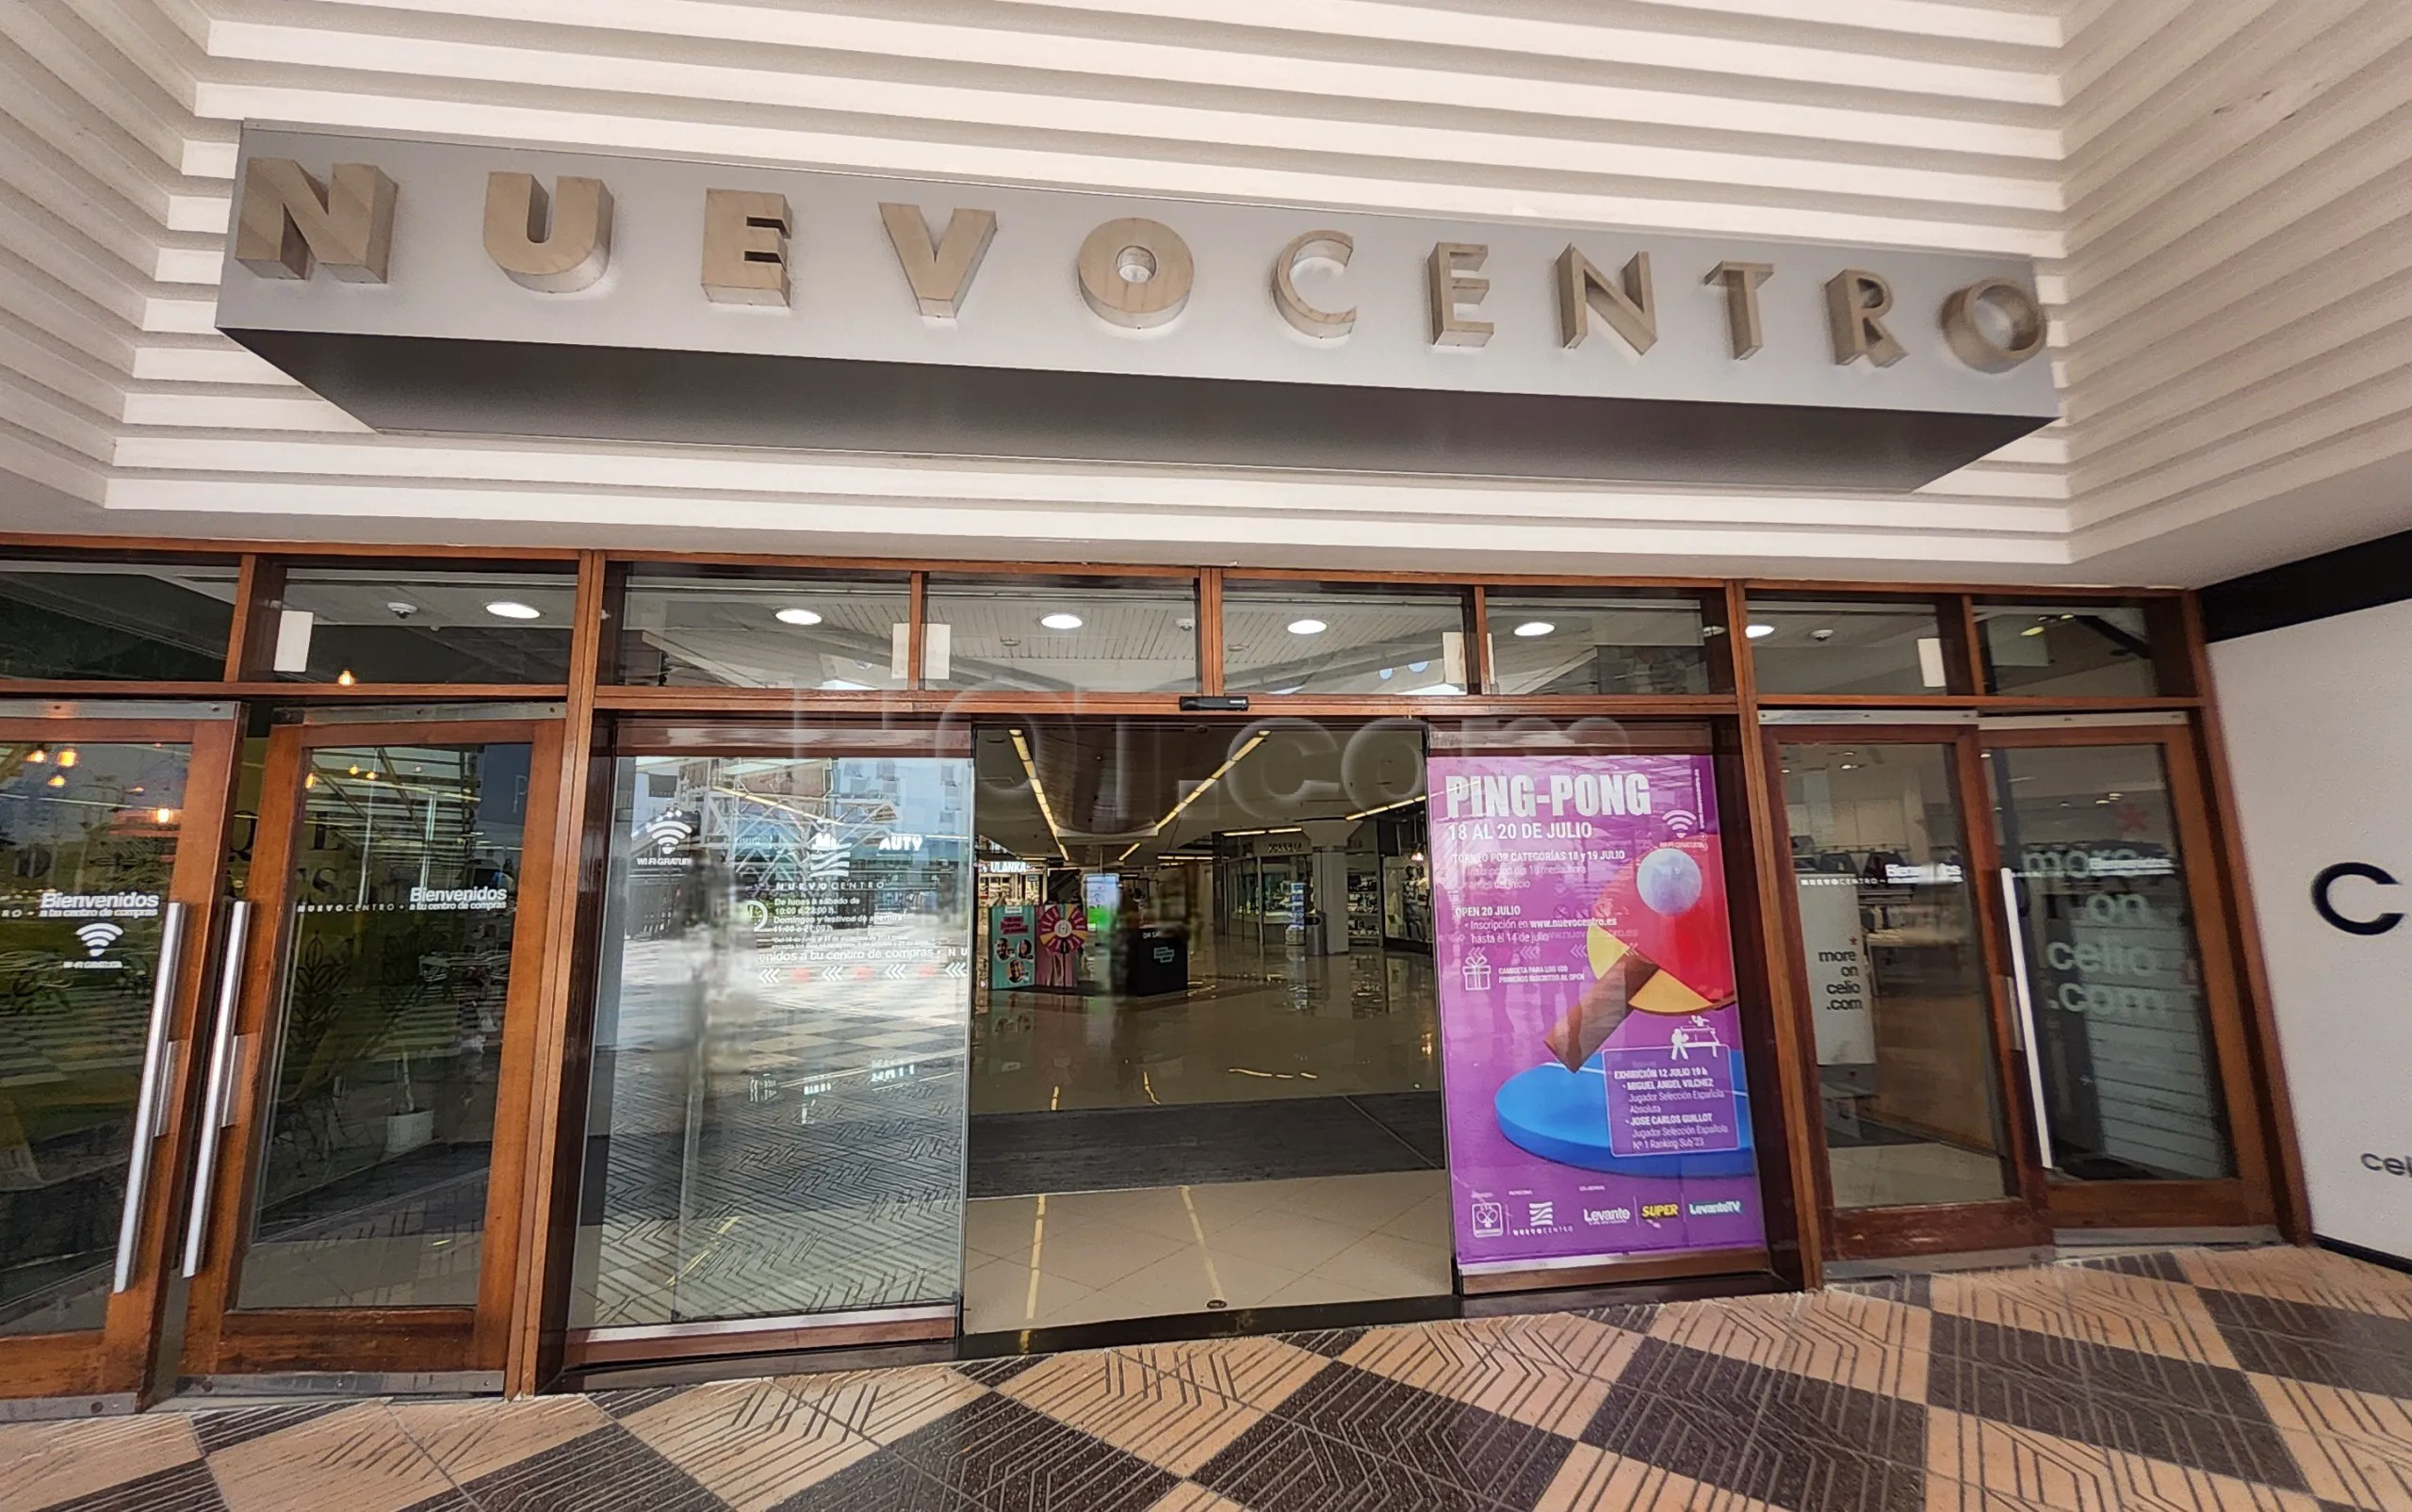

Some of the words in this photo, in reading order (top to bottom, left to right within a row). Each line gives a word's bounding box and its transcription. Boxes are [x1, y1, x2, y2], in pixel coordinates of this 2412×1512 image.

[235, 156, 2046, 374] NUEVOCENTRO
[1445, 773, 1652, 818] PING-PONG
[1448, 823, 1468, 841] 18
[1472, 823, 1494, 841] AL
[1497, 822, 1518, 840] 20
[1521, 821, 1542, 839] DE
[1546, 821, 1593, 839] JULIO
[1452, 853, 1488, 865] TORNEO
[1491, 853, 1509, 864] POR
[1511, 849, 1567, 862] CATEGORÍAS
[1580, 852, 1586, 863] y
[1588, 851, 1598, 861] 19
[1600, 850, 1625, 860] JULIO
[775, 880, 886, 891] NUEVOCENTRO
[41, 891, 159, 908] Bienvenidos
[410, 886, 508, 902] Bienvenidos
[297, 902, 395, 913] NUEVOCENTRO
[428, 902, 457, 911] centro
[458, 902, 469, 910] de
[470, 901, 507, 911] compras
[774, 898, 787, 906] De
[788, 897, 810, 906] lunes
[819, 897, 848, 905] sábado
[774, 906, 797, 916] 10:00
[1456, 906, 1480, 917] OPEN
[1481, 906, 1493, 917] 20
[1494, 905, 1521, 916] JULIO
[2085, 893, 2149, 925] on
[774, 916, 816, 925] Domingos
[824, 915, 856, 923] festivos
[1471, 919, 1522, 932] Inscripción
[1471, 933, 1496, 945] hasta
[1497, 932, 1505, 943] el
[1506, 932, 1518, 944] 14
[1519, 933, 1530, 943] de
[1531, 931, 1550, 944] julio
[800, 951, 808, 962] a
[810, 950, 824, 961] tu
[826, 950, 865, 961] centro
[867, 948, 883, 959] de
[886, 947, 934, 961] compras
[1818, 950, 1857, 963] more
[2046, 935, 2158, 978] celio
[1840, 965, 1858, 977] on
[1826, 980, 1861, 995] celio
[1826, 999, 1863, 1011] .com
[1614, 1067, 1657, 1080] EXHIBICIÓN
[1658, 1068, 1668, 1078] 12
[1669, 1067, 1691, 1078] JULIO
[1627, 1081, 1655, 1091] MIGUEL
[1656, 1080, 1682, 1089] ANGEL
[1682, 1078, 1715, 1088] VILCHEZ
[1628, 1092, 1658, 1104] Jugador
[1658, 1091, 1692, 1102] Selección
[1693, 1089, 1725, 1101] Española
[1630, 1104, 1661, 1114] Absoluta
[1651, 1114, 1681, 1125] CARLOS
[1681, 1113, 1713, 1123] GUILLOT
[1632, 1128, 1661, 1139] Jugador
[1662, 1126, 1696, 1137] Selección
[1697, 1125, 1729, 1136] Española
[1650, 1138, 1679, 1150] Ranking
[1583, 1207, 1631, 1223] Levante
[1641, 1203, 1679, 1218] SUPER
